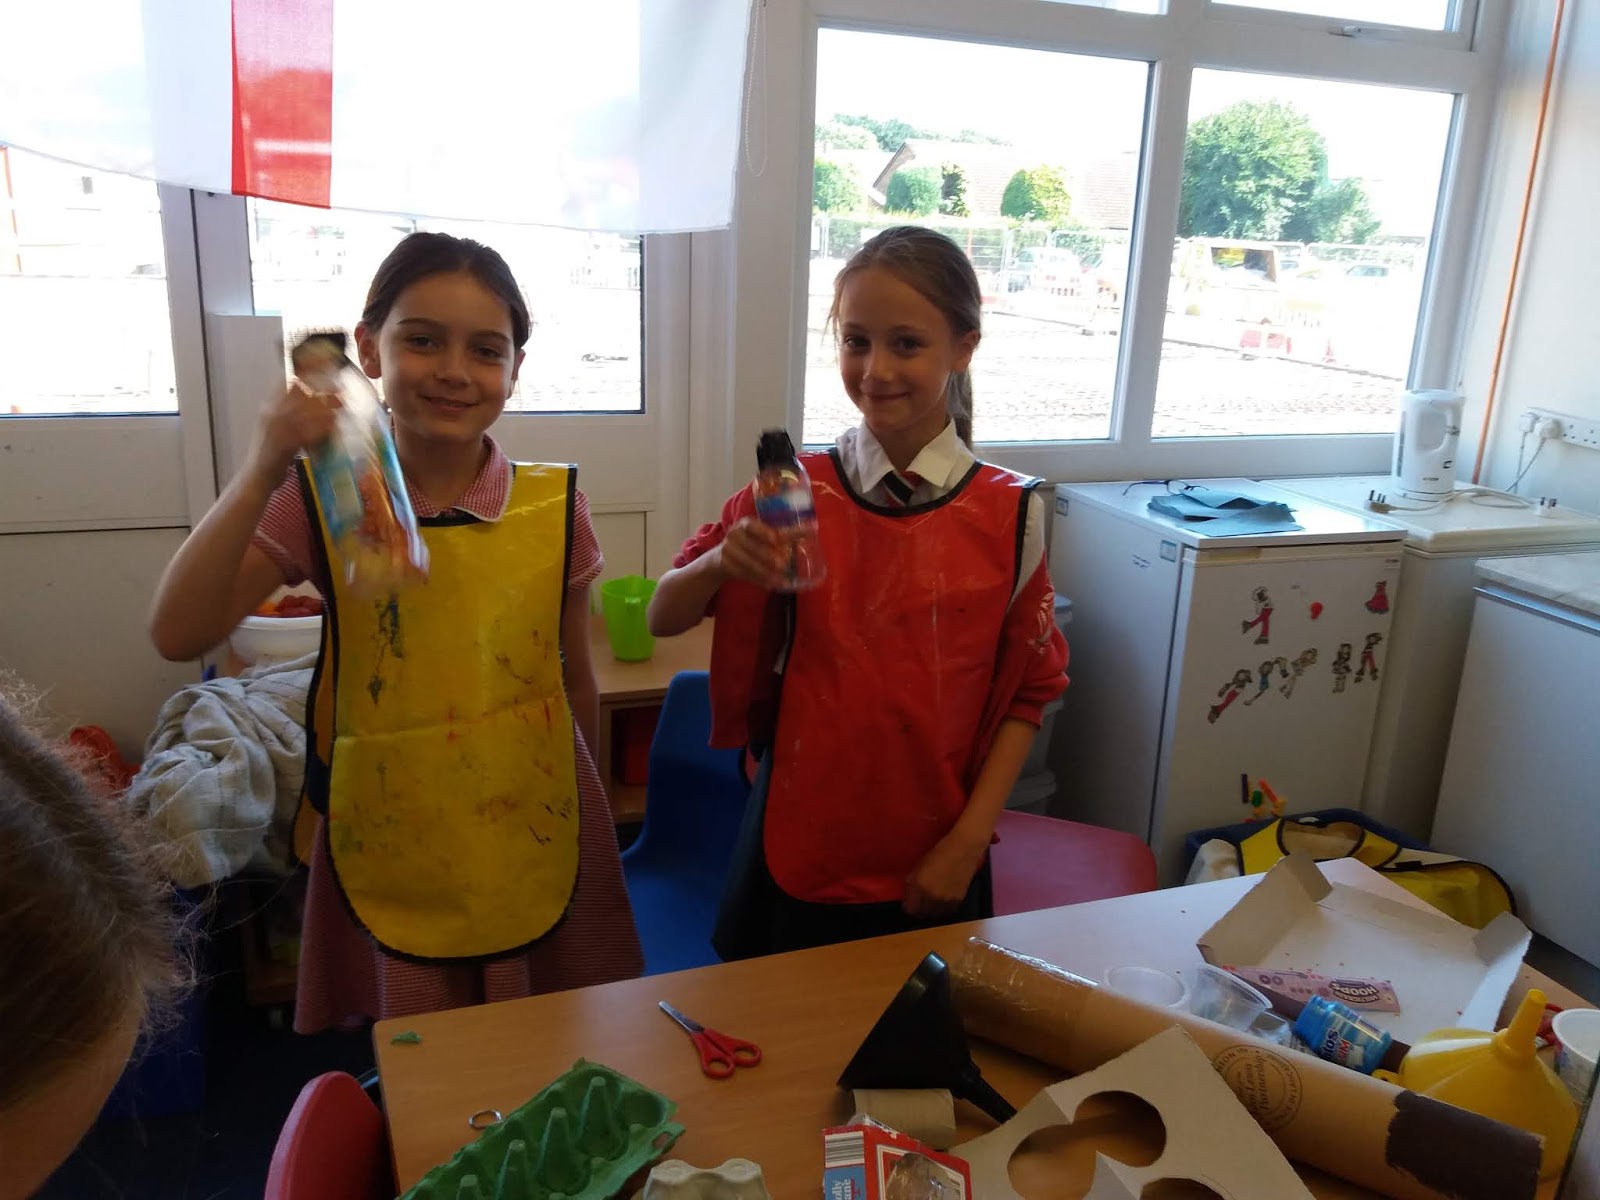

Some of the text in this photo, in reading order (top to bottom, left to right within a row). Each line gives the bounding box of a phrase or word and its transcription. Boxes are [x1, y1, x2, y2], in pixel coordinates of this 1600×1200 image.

[1331, 982, 1378, 996] HOOPS
[831, 1180, 843, 1200] olly
[842, 1178, 852, 1200] ane
